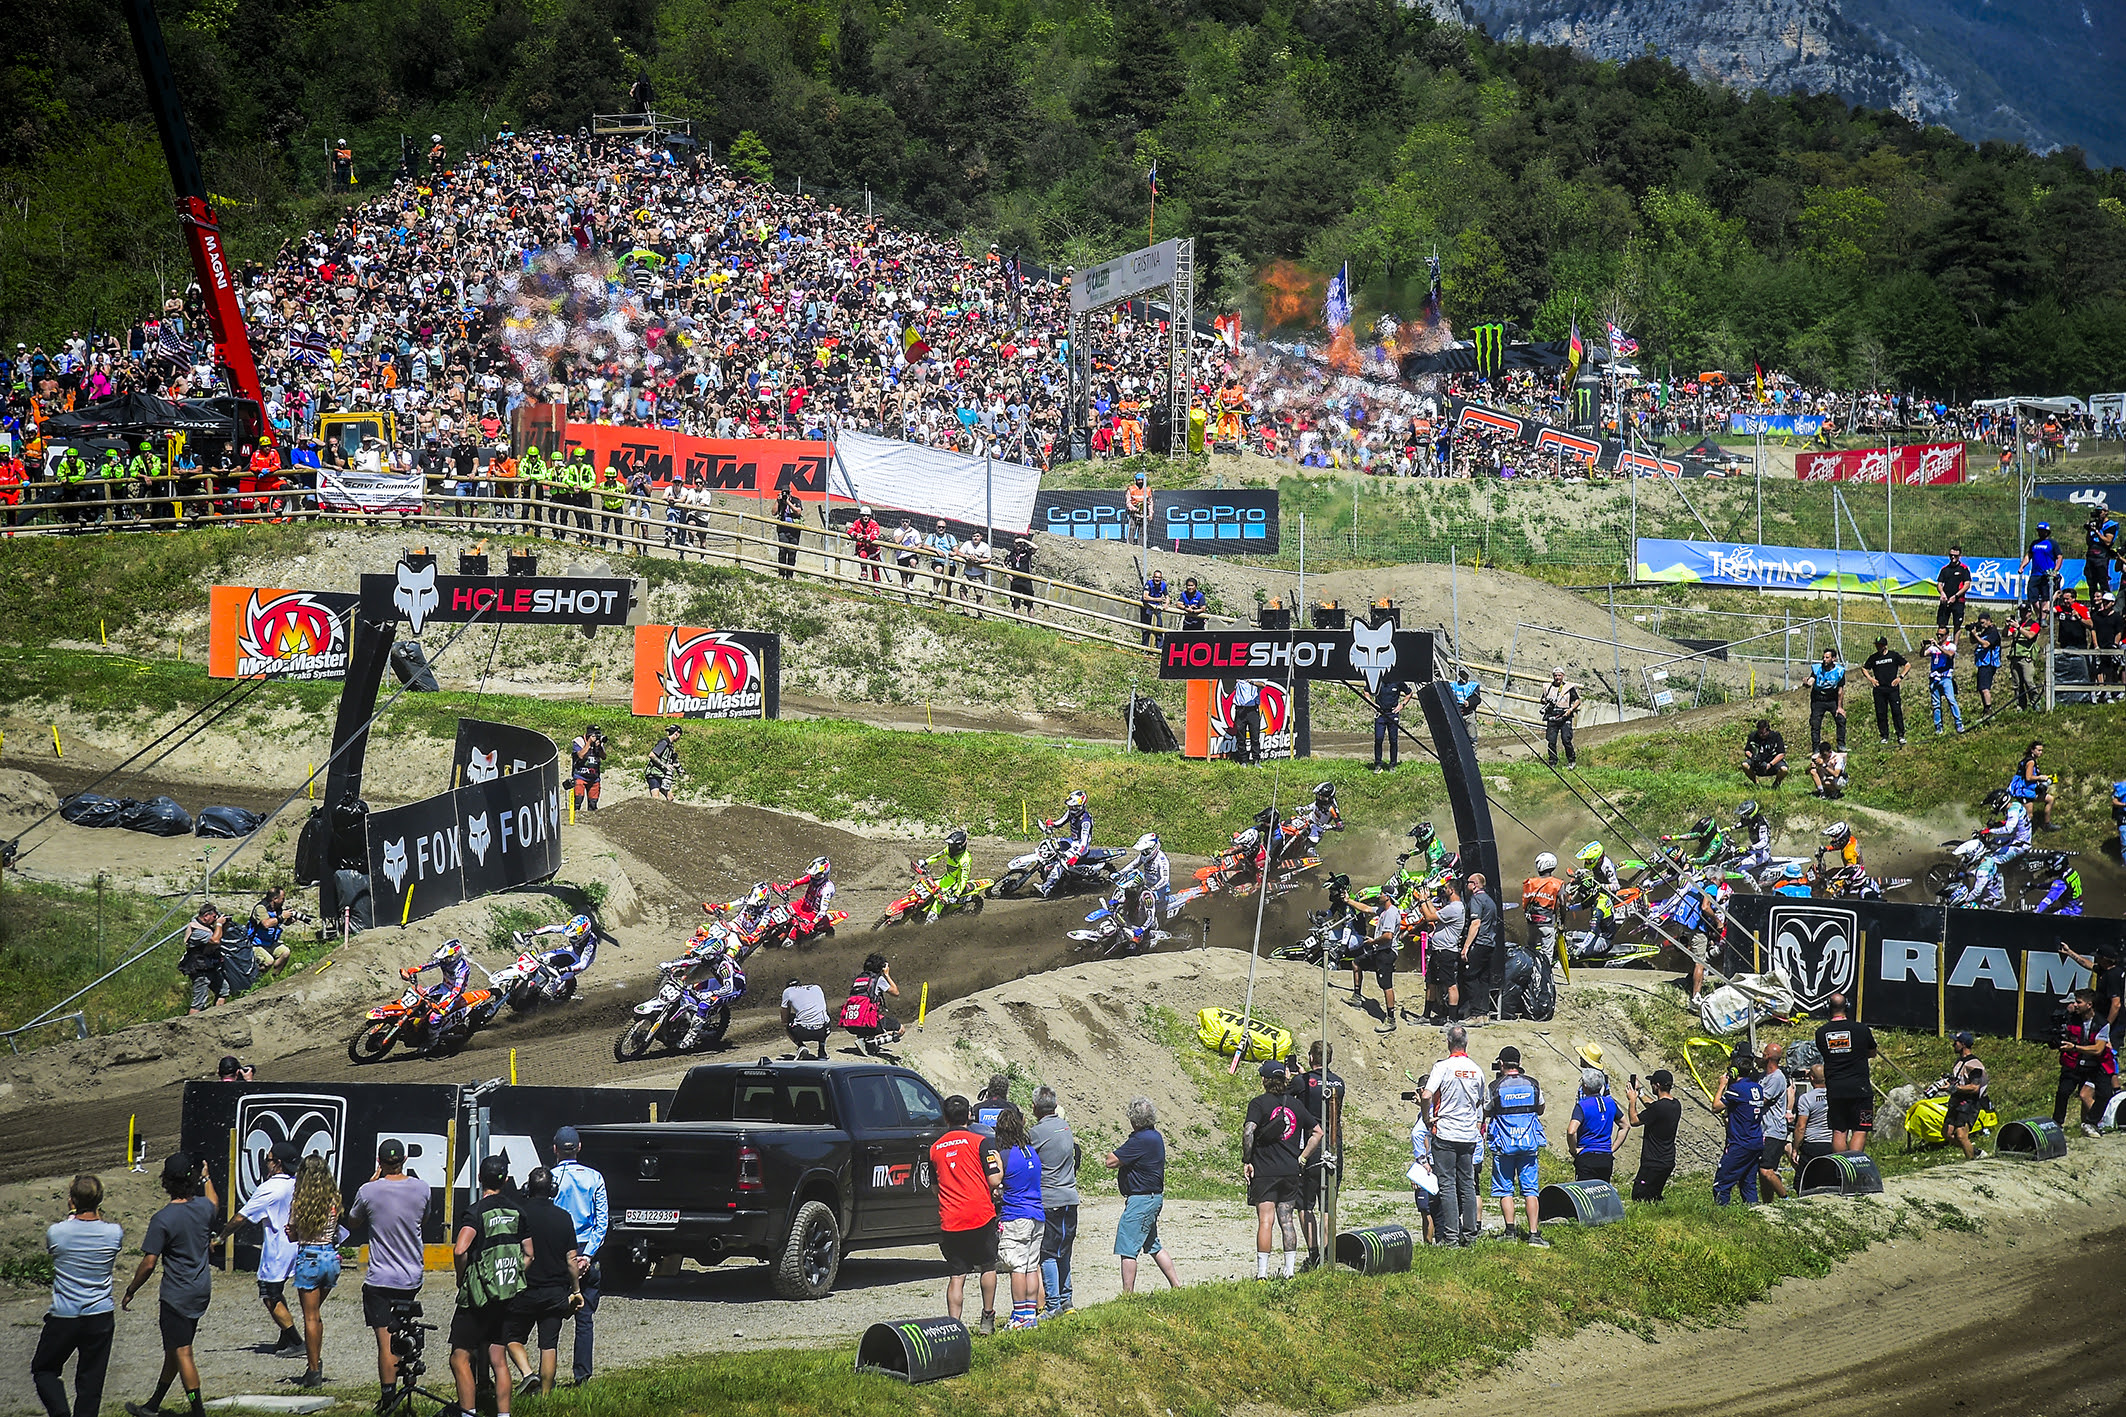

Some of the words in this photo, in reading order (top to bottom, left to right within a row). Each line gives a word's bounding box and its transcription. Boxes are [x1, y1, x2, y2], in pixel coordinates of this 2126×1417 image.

[204, 235, 228, 290] MAGNI
[609, 442, 674, 483] KTM
[686, 452, 757, 491] KTM
[774, 456, 833, 492] KT
[345, 481, 373, 489] SCAVI
[1047, 505, 1130, 522] GoPr
[1166, 505, 1266, 522] GoPro
[1707, 550, 1818, 585] TRENTINO
[452, 587, 619, 615] HOLESHOT
[1167, 641, 1336, 667] HOLESHOT
[313, 668, 346, 678] Systems
[704, 709, 728, 720] Brake
[729, 708, 761, 719] Systems
[500, 799, 547, 854] FOX
[416, 824, 462, 881] FOX
[1881, 939, 2095, 995] RAM
[845, 1010, 860, 1020] 189
[1218, 1009, 1281, 1040] THOR
[1829, 1039, 1850, 1048] KTM
[1454, 1070, 1477, 1079] GET
[936, 1138, 969, 1151] HONDA
[922, 1323, 962, 1338] MONSTER
[934, 1335, 959, 1344] ENERGY
